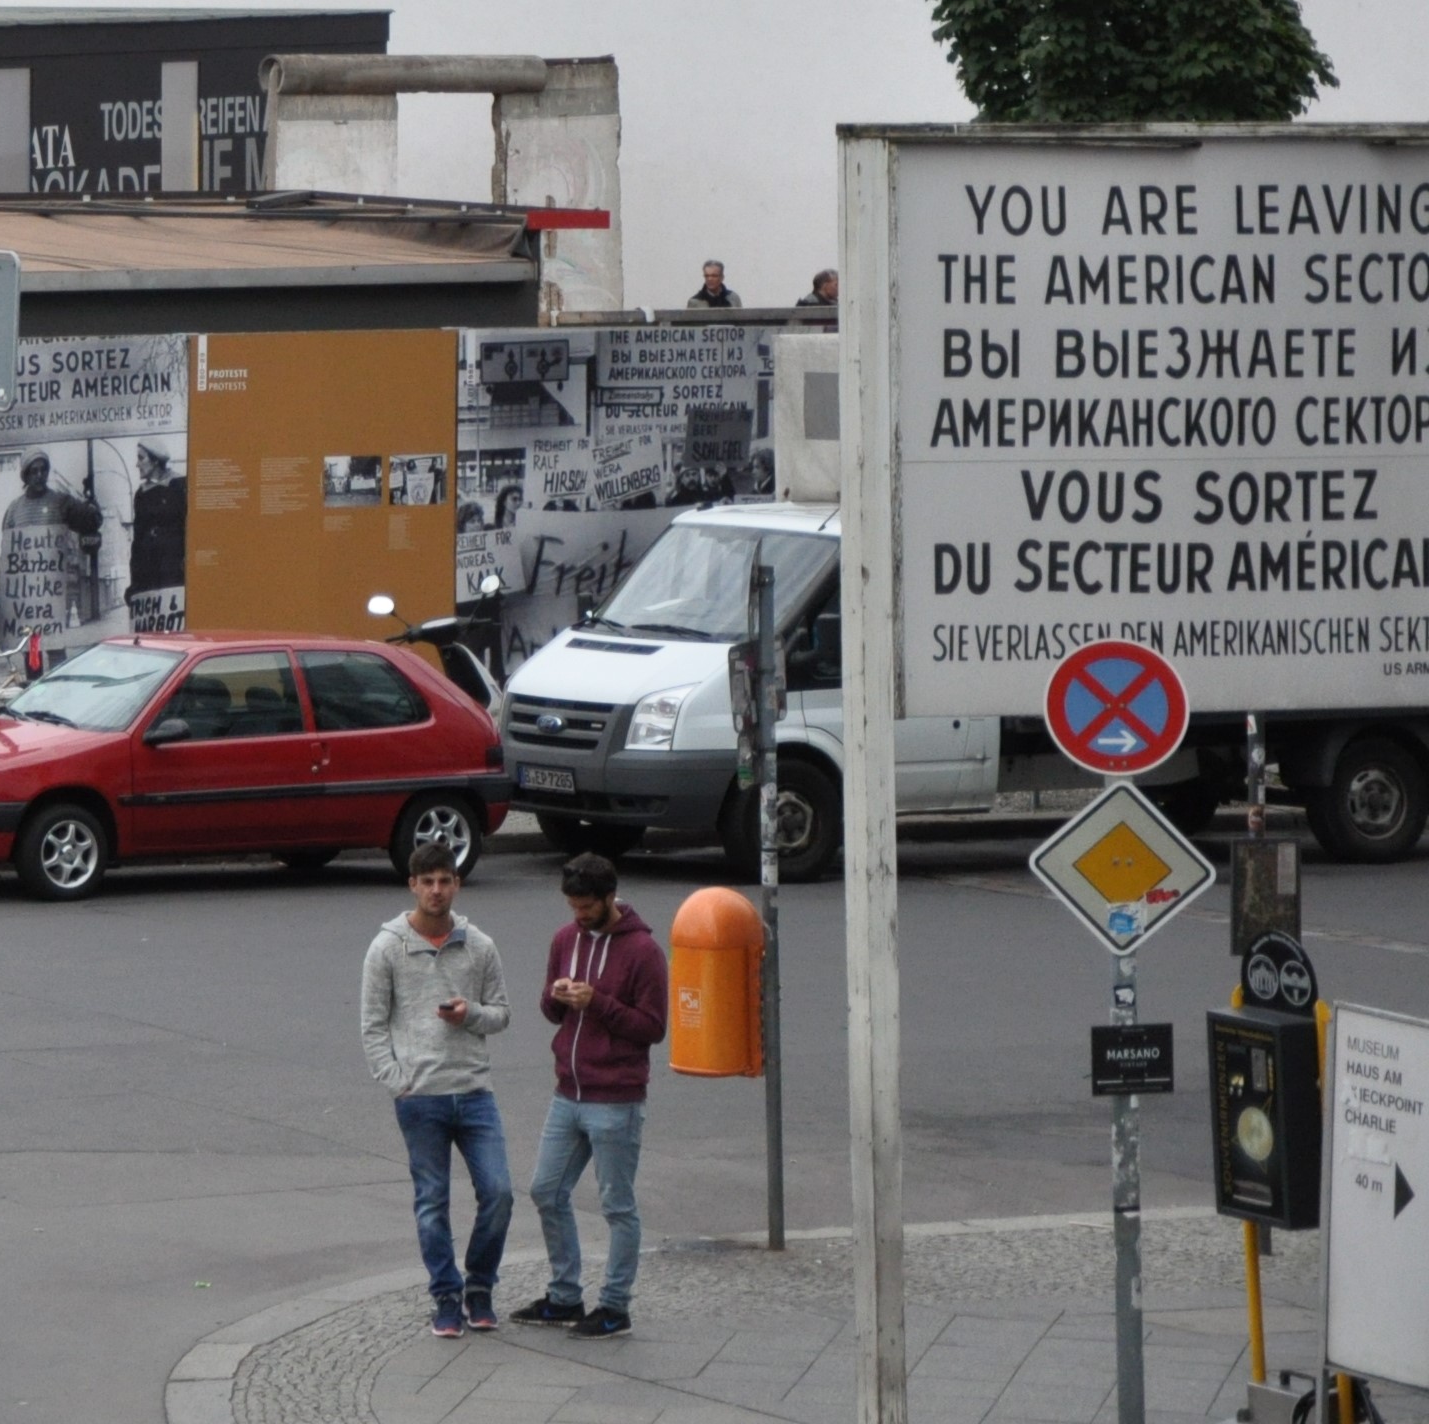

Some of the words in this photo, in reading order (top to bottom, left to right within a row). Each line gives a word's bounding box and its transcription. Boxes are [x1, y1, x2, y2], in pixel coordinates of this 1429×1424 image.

[964, 184, 1067, 236] YOU
[1101, 184, 1198, 235] ARE
[1235, 183, 1429, 235] LEAVING
[937, 253, 1017, 305] THE
[1044, 253, 1276, 305] AMERICAN
[609, 330, 630, 345] THE
[635, 329, 696, 344] AMERICAN
[701, 328, 746, 343] SECTOR
[52, 347, 131, 374] SORTEZ
[943, 328, 1021, 379] ВЫ
[1056, 327, 1357, 379] ВЫЕЗЖАЕТЕ
[208, 368, 248, 379] PROTESTE
[208, 381, 247, 391] PROTESTS
[672, 384, 723, 400] SORTEZ
[27, 411, 46, 428] DEN
[49, 407, 135, 427] AMERIKANISCHEN
[137, 403, 173, 421] SEKTOR
[930, 396, 1277, 448] АМЕРИКАНСКОГО
[532, 454, 560, 471] RALF
[593, 464, 623, 480] WERA
[543, 470, 588, 494] HIRSCH
[1020, 469, 1163, 523] VOUS
[1194, 469, 1378, 525] SORTEZ
[11, 530, 65, 551] Heute
[6, 552, 65, 574] Bärbel
[457, 551, 495, 569] NDREAS
[934, 541, 991, 595] DU
[1013, 539, 1213, 596] SECTEUR
[5, 576, 63, 599] Ulrike
[12, 601, 54, 620] Vera
[932, 623, 969, 662] SIE
[1173, 617, 1369, 657] AMERIKANISCHEN
[1383, 662, 1402, 675] US
[1106, 1047, 1160, 1060] MARSANO
[1347, 1035, 1400, 1061] MUSEUM
[1346, 1059, 1380, 1081] HAUS
[1383, 1070, 1403, 1087] AM
[1344, 1108, 1397, 1134] CHARLIE
[1354, 1173, 1369, 1191] 40
[1371, 1179, 1383, 1193] m
